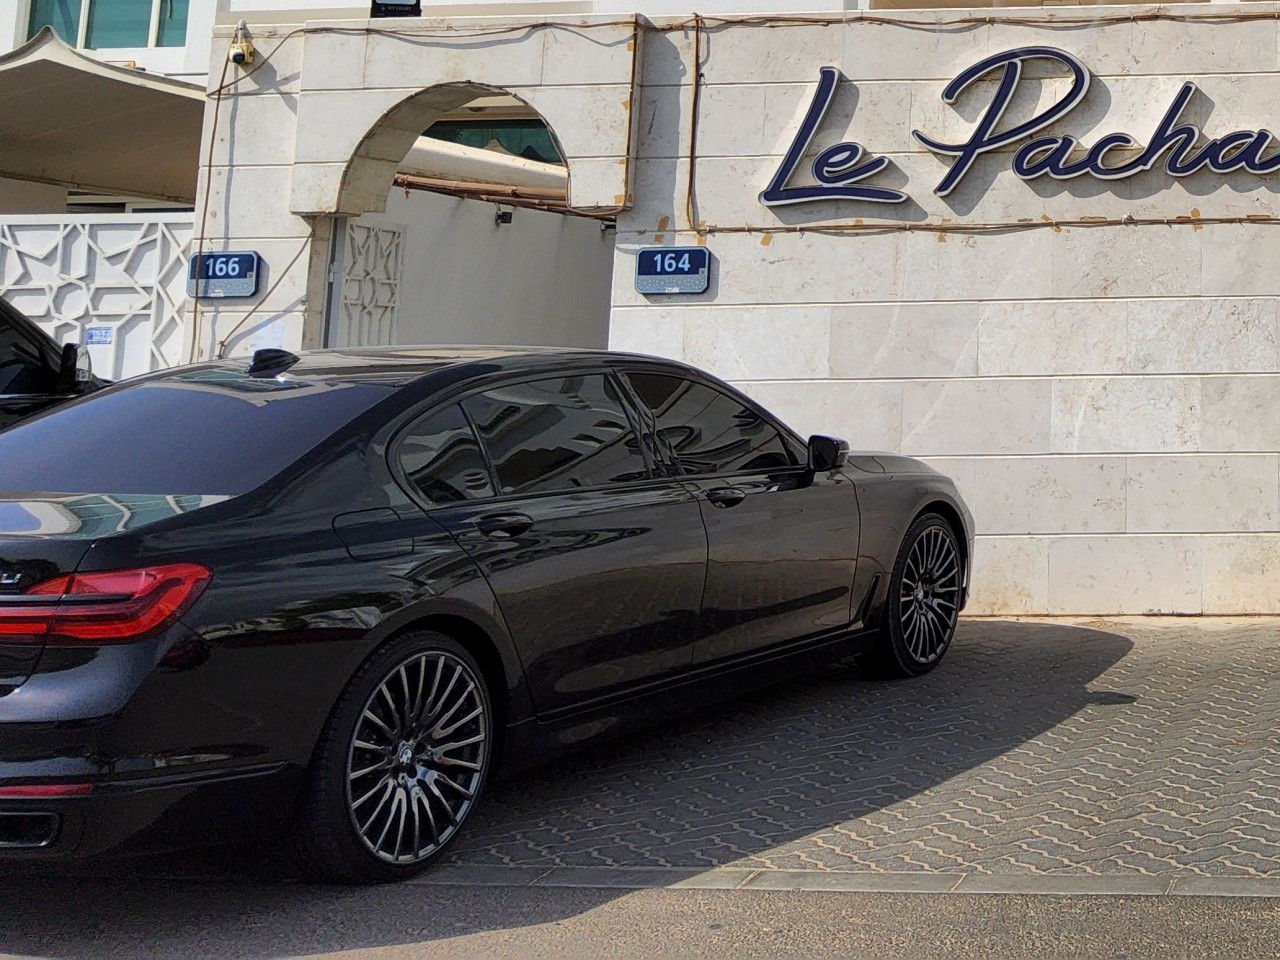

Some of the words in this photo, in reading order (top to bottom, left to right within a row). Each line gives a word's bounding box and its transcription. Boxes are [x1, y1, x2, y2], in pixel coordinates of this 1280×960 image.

[759, 66, 909, 207] Le
[206, 257, 239, 277] 166
[653, 253, 691, 272] 164
